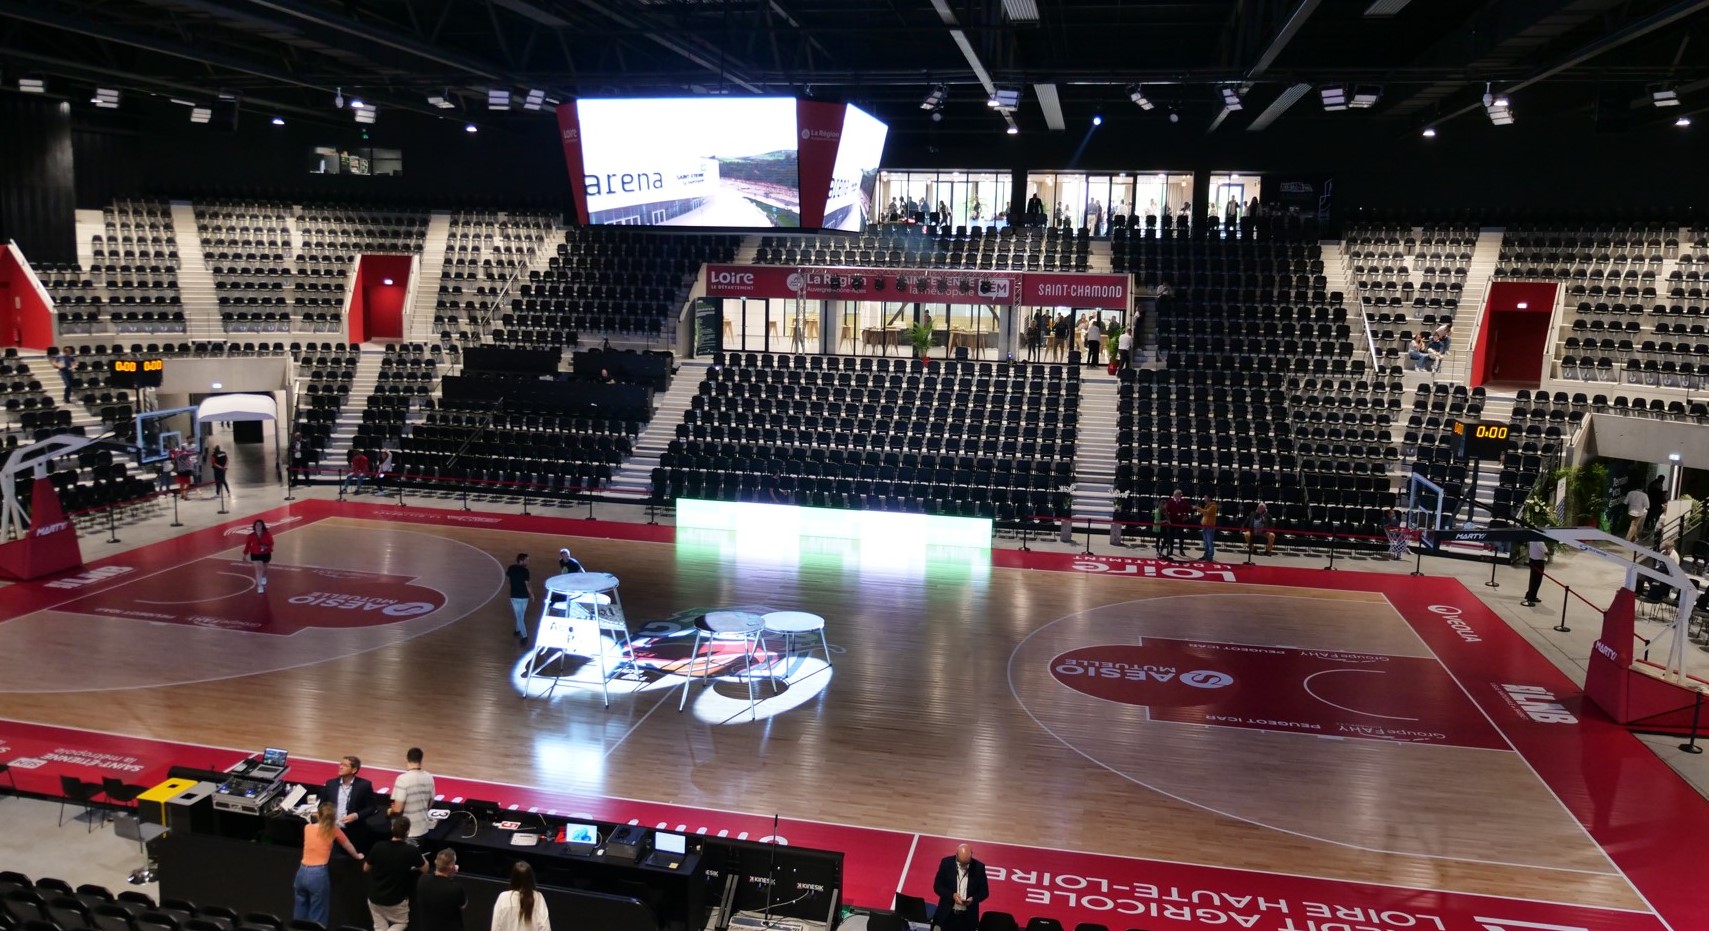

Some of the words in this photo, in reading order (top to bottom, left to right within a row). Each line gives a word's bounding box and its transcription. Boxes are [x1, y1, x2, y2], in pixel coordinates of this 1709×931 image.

[584, 172, 663, 196] arena
[711, 271, 754, 284] Loire
[807, 274, 821, 285] La
[823, 275, 867, 287] Rgin
[909, 286, 918, 295] la
[1476, 426, 1508, 439] 0:00
[1072, 561, 1236, 582] Loire
[309, 591, 398, 605] MUTUELLE
[1442, 615, 1482, 642] VEOLIA
[1065, 658, 1176, 673] MUTUELLE
[1205, 714, 1242, 722] ICAR
[1246, 718, 1321, 730] PEUGEOT
[985, 865, 1289, 914] HAUTE-LOIRE
[1025, 888, 1261, 928] AGRICOLE
[1302, 901, 1446, 931] LOIRE
